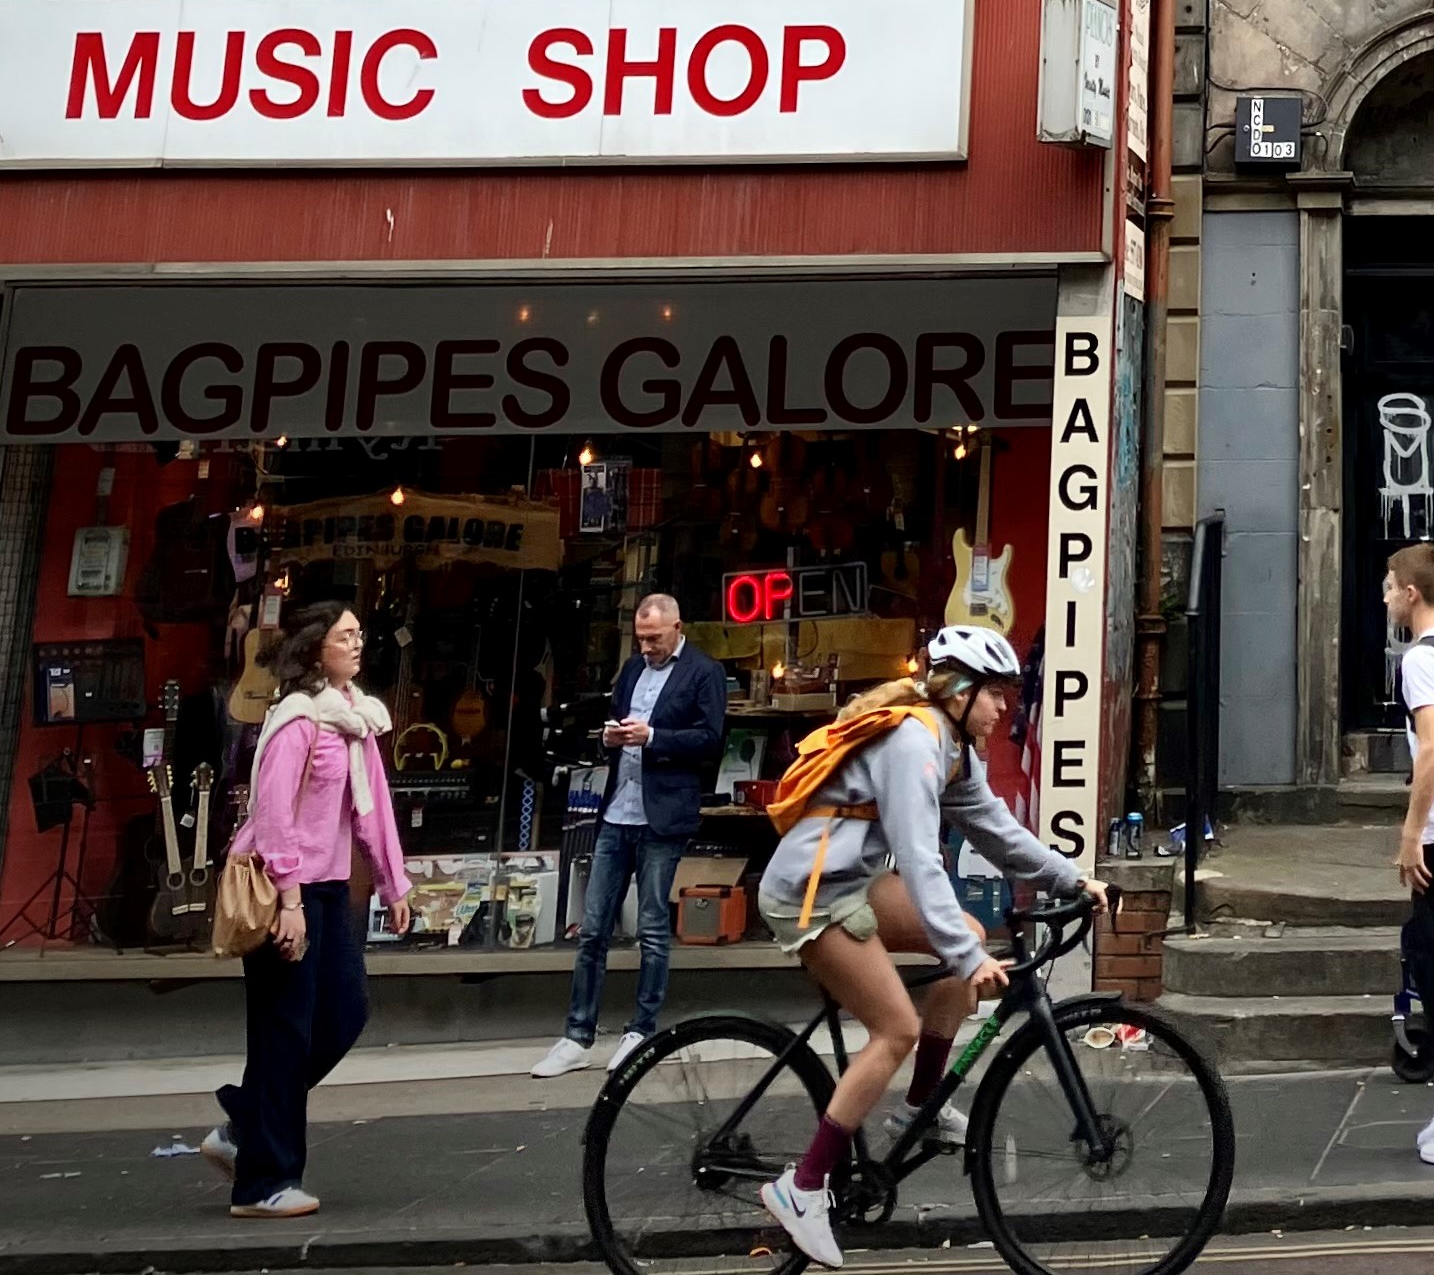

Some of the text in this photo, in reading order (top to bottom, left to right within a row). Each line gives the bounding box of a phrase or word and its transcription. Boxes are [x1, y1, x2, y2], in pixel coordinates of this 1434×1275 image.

[65, 24, 847, 121] MUSIC SHOP
[4, 330, 1054, 439] BAGPIPES GALORE
[403, 514, 524, 552] GALORE
[727, 567, 865, 623] OPEN
[1047, 330, 1101, 860] BAGPIPES
